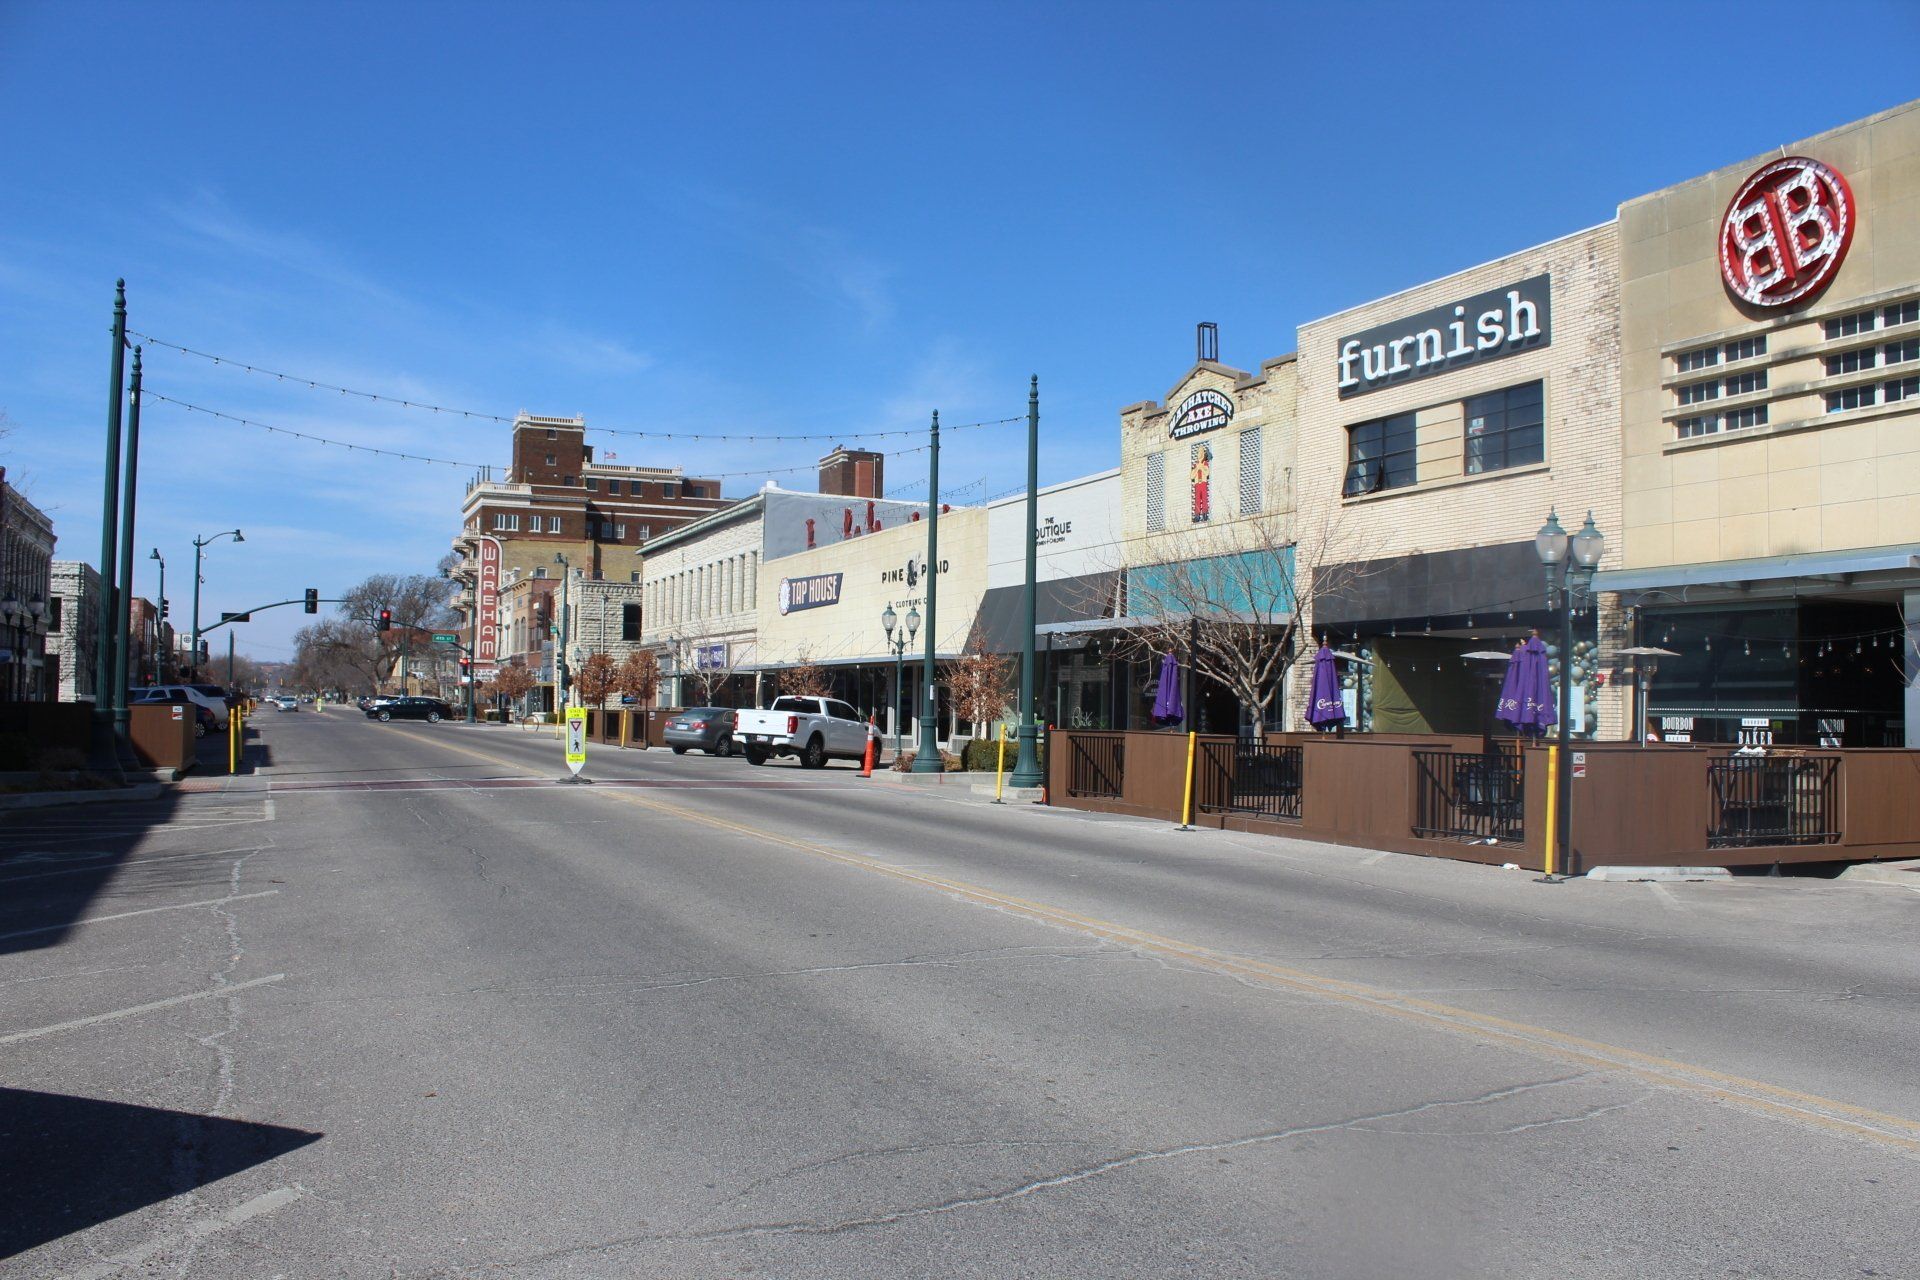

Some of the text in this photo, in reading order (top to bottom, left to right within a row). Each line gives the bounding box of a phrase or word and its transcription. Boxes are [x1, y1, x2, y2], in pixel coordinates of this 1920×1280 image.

[1338, 290, 1541, 388] furnish
[1186, 404, 1212, 424] AXE
[1174, 415, 1226, 438] THROWING
[1035, 521, 1072, 540] OUTIQUE
[1045, 517, 1055, 525] THE
[881, 568, 904, 585] PINE
[921, 559, 949, 577] PID
[481, 546, 496, 656] WAREHAM
[791, 580, 808, 606] TAP
[808, 575, 837, 604] HOUSE
[1662, 716, 1694, 731] BOURBON
[1738, 731, 1773, 745] BAKER
